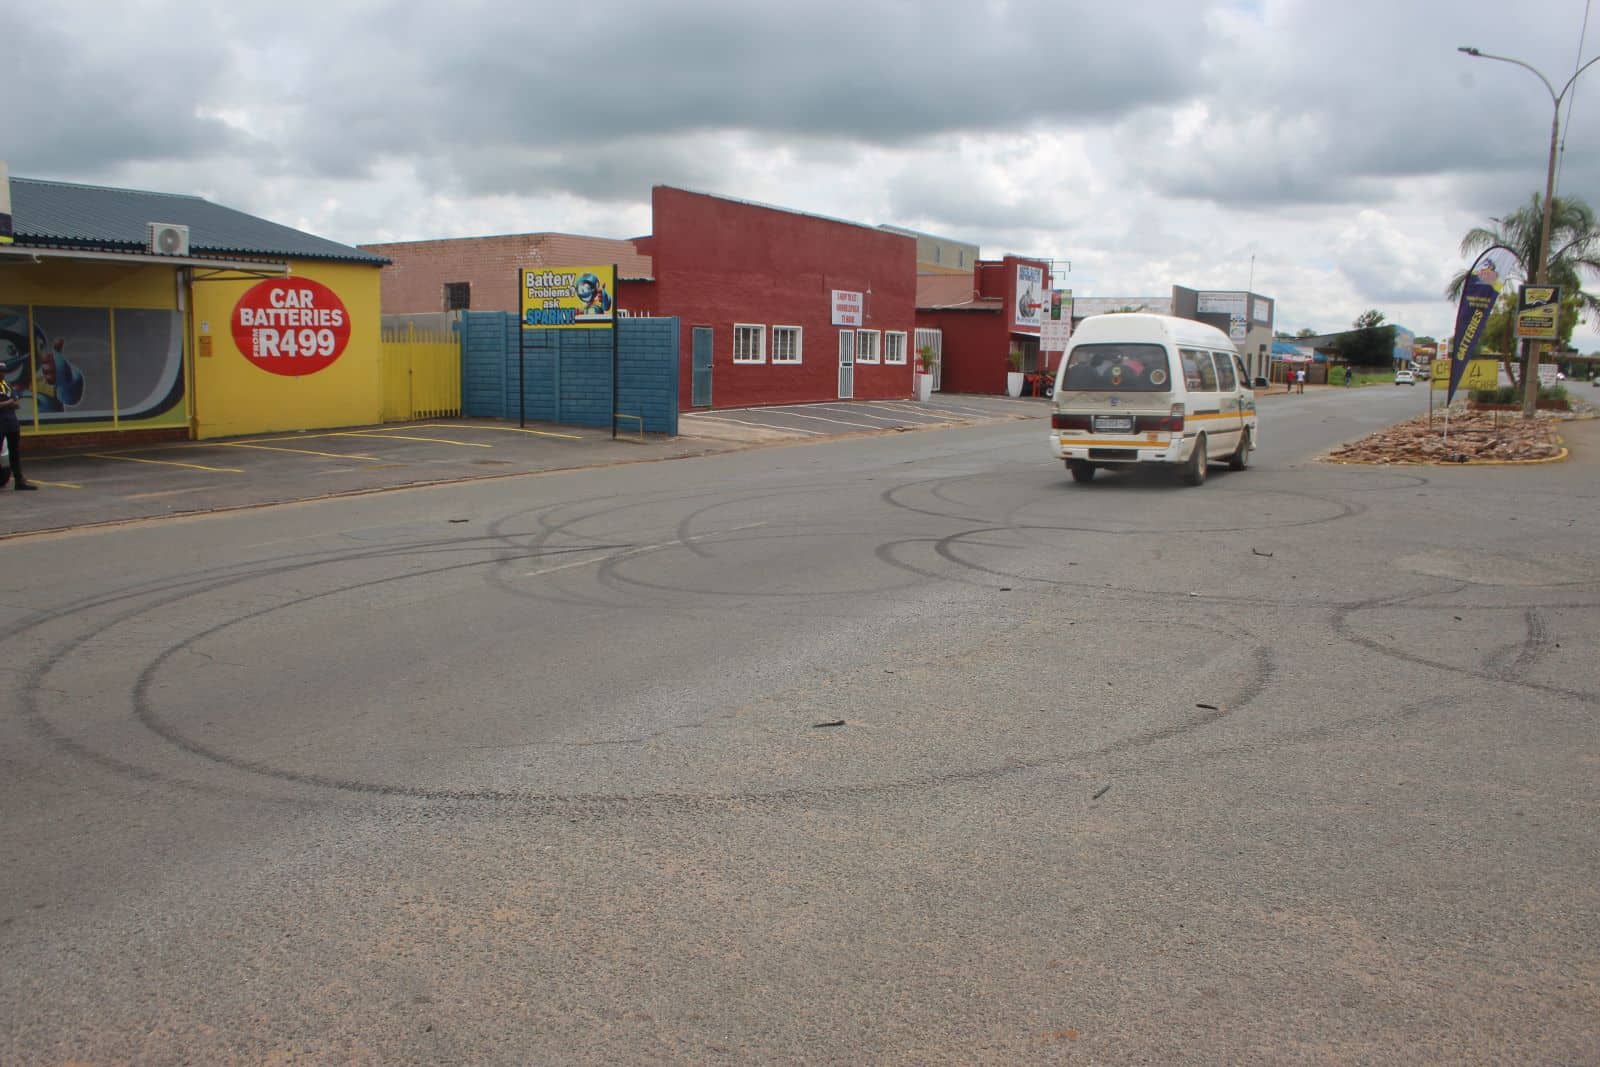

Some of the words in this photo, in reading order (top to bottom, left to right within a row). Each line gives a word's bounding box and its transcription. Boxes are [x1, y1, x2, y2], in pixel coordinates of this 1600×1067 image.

[526, 271, 576, 288] Battery
[270, 288, 314, 308] CAR
[528, 286, 576, 298] Problems?
[543, 299, 560, 309] ask
[240, 308, 343, 327] BATTERIES
[527, 308, 576, 325] SPARKY!
[252, 328, 260, 357] FROM
[260, 328, 335, 357] R499
